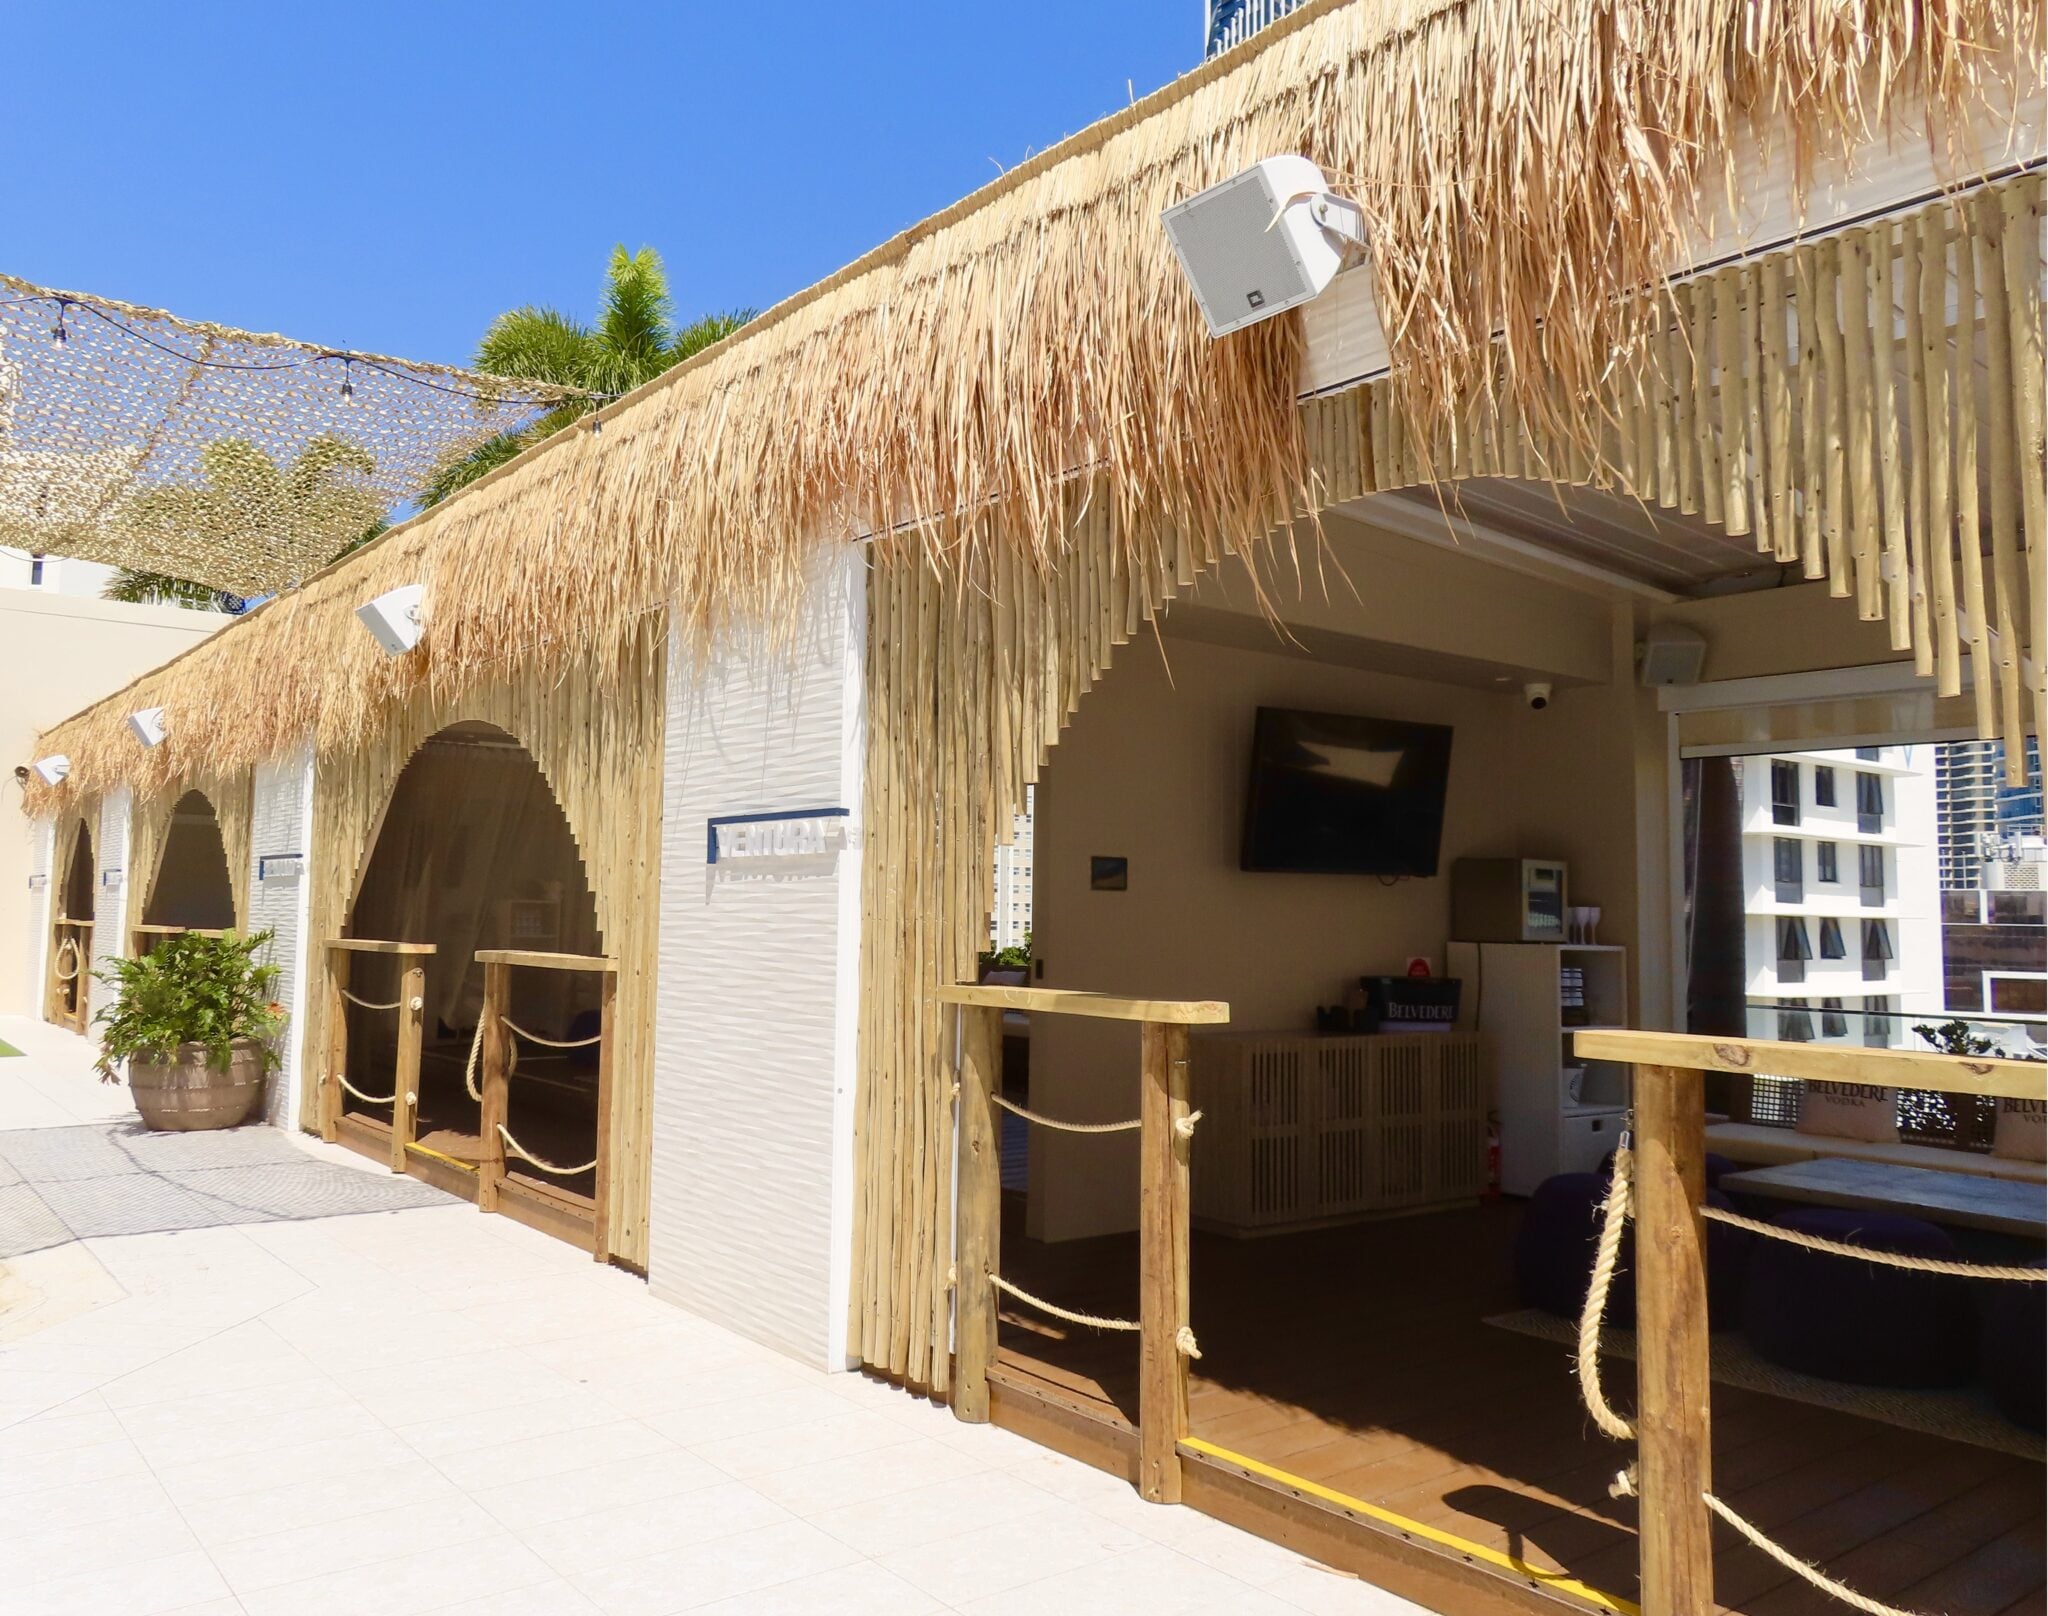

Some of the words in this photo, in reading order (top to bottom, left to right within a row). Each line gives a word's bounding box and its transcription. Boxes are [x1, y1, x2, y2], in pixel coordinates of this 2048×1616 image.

[1387, 1001, 1455, 1020] BELVEDERE
[1807, 1080, 1889, 1103] BELVEDERE
[1824, 1095, 1866, 1108] VODKA
